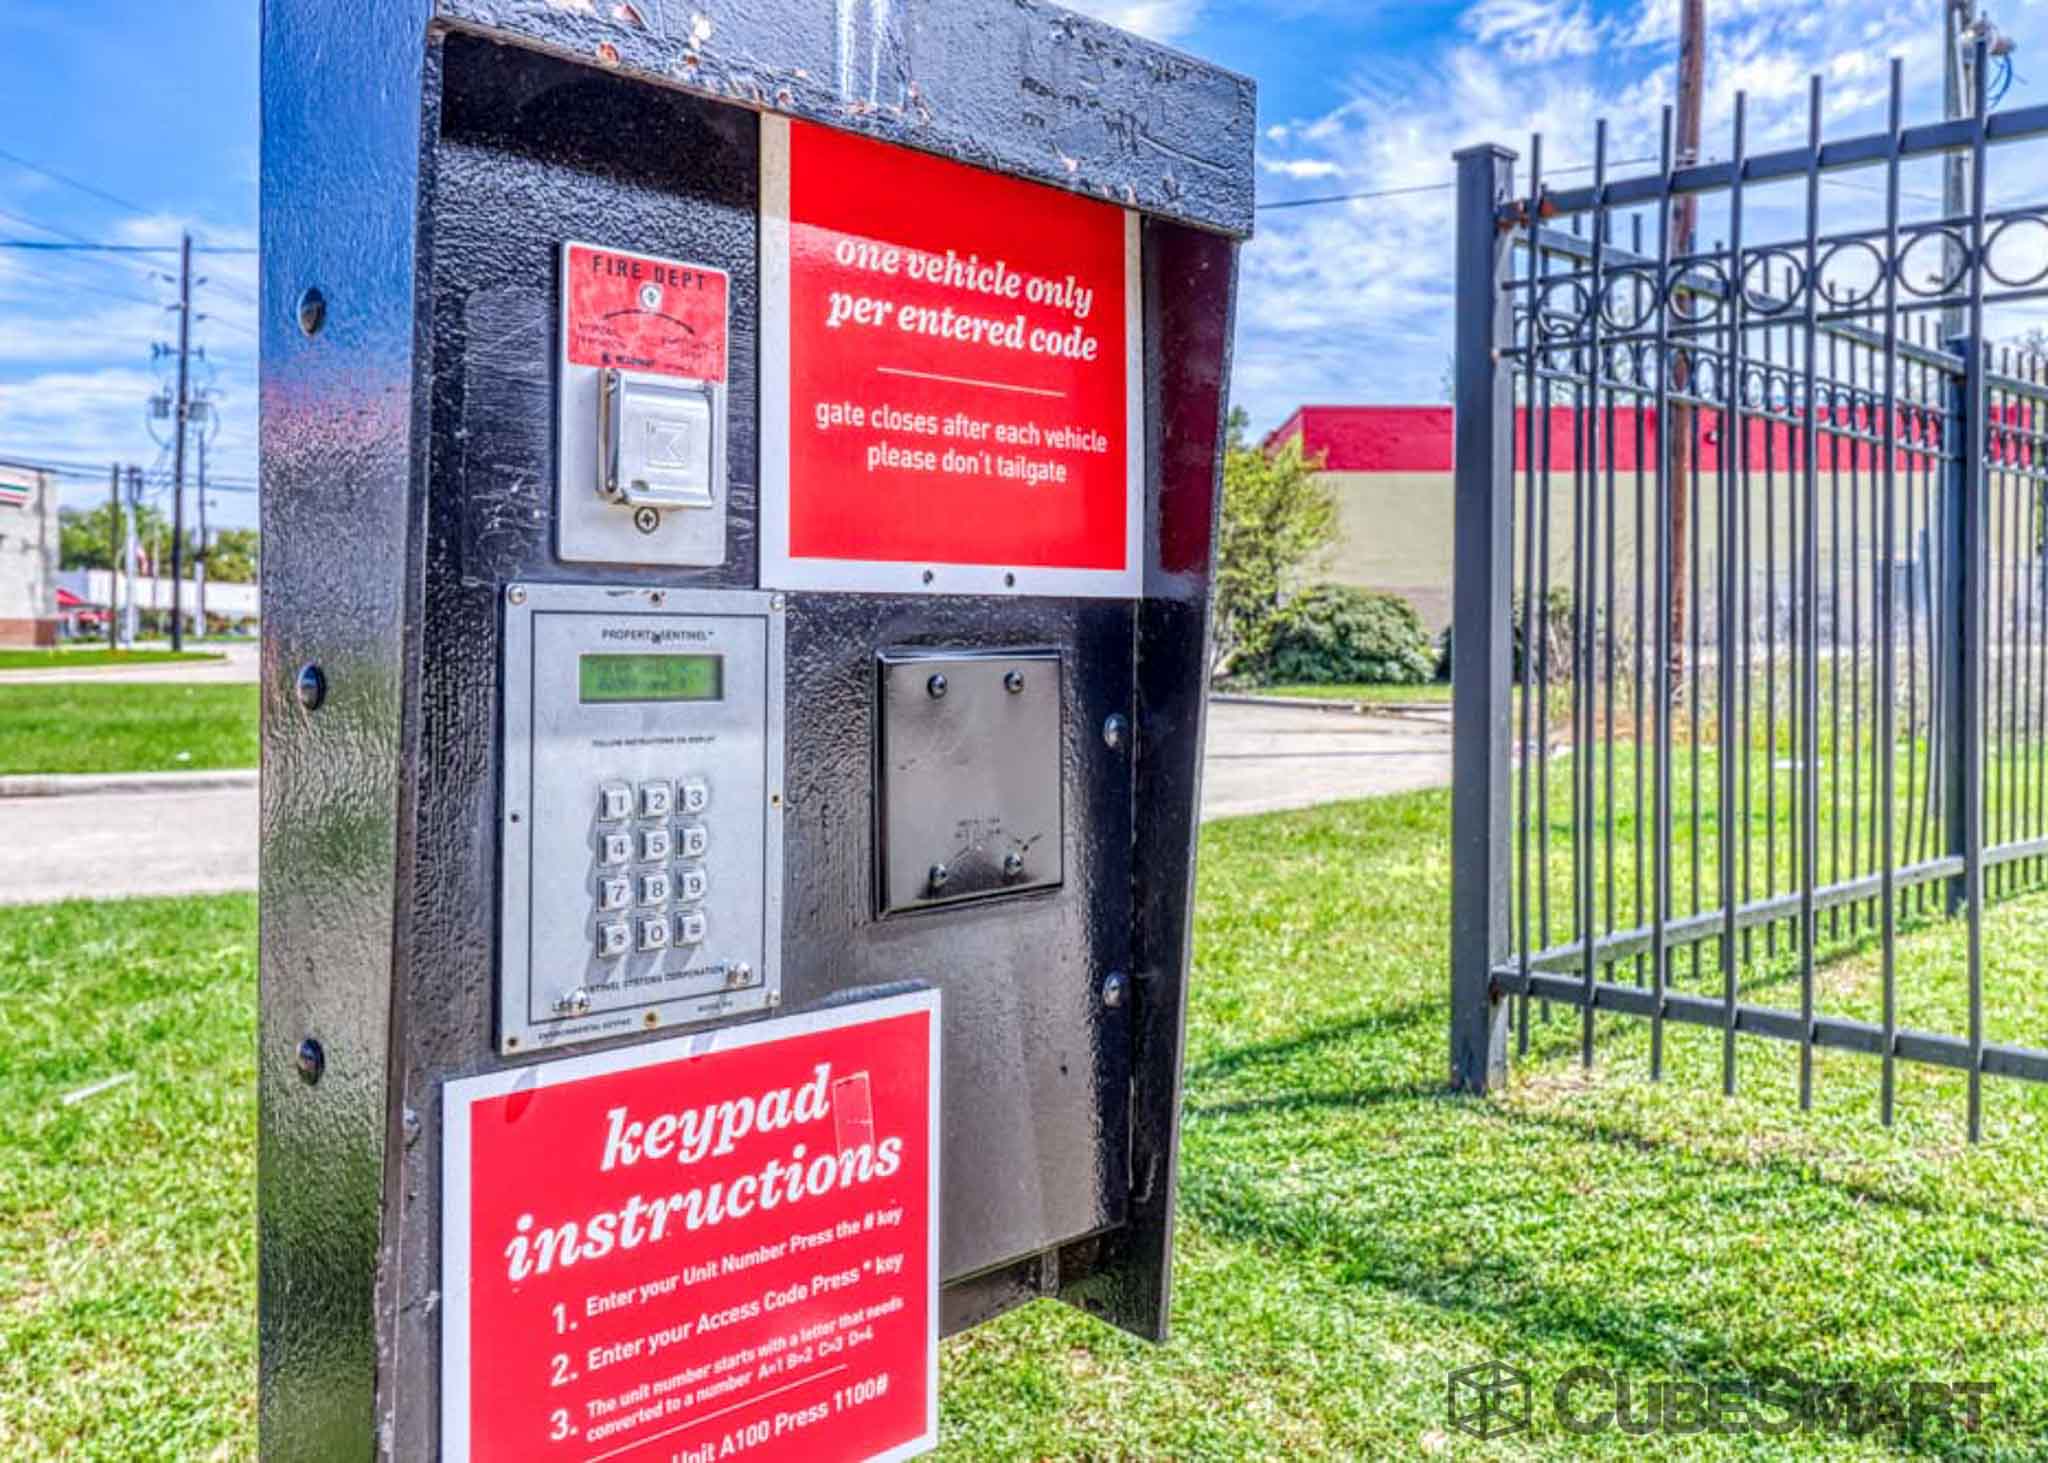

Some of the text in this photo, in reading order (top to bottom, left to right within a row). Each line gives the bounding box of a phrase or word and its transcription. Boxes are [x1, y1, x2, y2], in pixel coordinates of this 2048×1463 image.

[592, 254, 705, 291] FIRE DEPT
[836, 238, 1093, 318] one vehicle only
[826, 290, 1098, 361] per entered code
[816, 402, 1107, 453] gate closes after each vehicle
[867, 441, 1067, 486] please don't tailgate
[613, 791, 702, 811] 1 2 3
[613, 834, 702, 856] 4 5 6
[613, 878, 701, 901] 7 8 9
[651, 925, 663, 942] 0
[600, 1062, 832, 1172] keypad
[505, 1136, 902, 1281] instructions
[552, 1304, 579, 1334] 1.
[586, 1288, 637, 1317] Enter
[640, 1274, 680, 1303] your
[683, 1261, 718, 1286] Unit
[721, 1242, 787, 1275] Number
[790, 1228, 833, 1253] Press
[836, 1221, 860, 1239] the
[876, 1207, 903, 1227] key
[551, 1353, 579, 1386] 2.
[587, 1337, 645, 1371] Enter
[648, 1322, 693, 1355] your
[696, 1300, 760, 1334] Access
[763, 1283, 808, 1311] Code
[811, 1267, 859, 1296] Press
[876, 1253, 904, 1275] key
[586, 1297, 904, 1418] The unit number starts with a letter that needs
[550, 1408, 579, 1440] 3.
[586, 1400, 664, 1443] converted
[666, 1397, 681, 1413] to
[684, 1393, 694, 1407] a
[696, 1371, 753, 1402] number
[719, 1419, 770, 1457] A100
[774, 1401, 829, 1436] Press
[834, 1373, 889, 1412] 1100#
